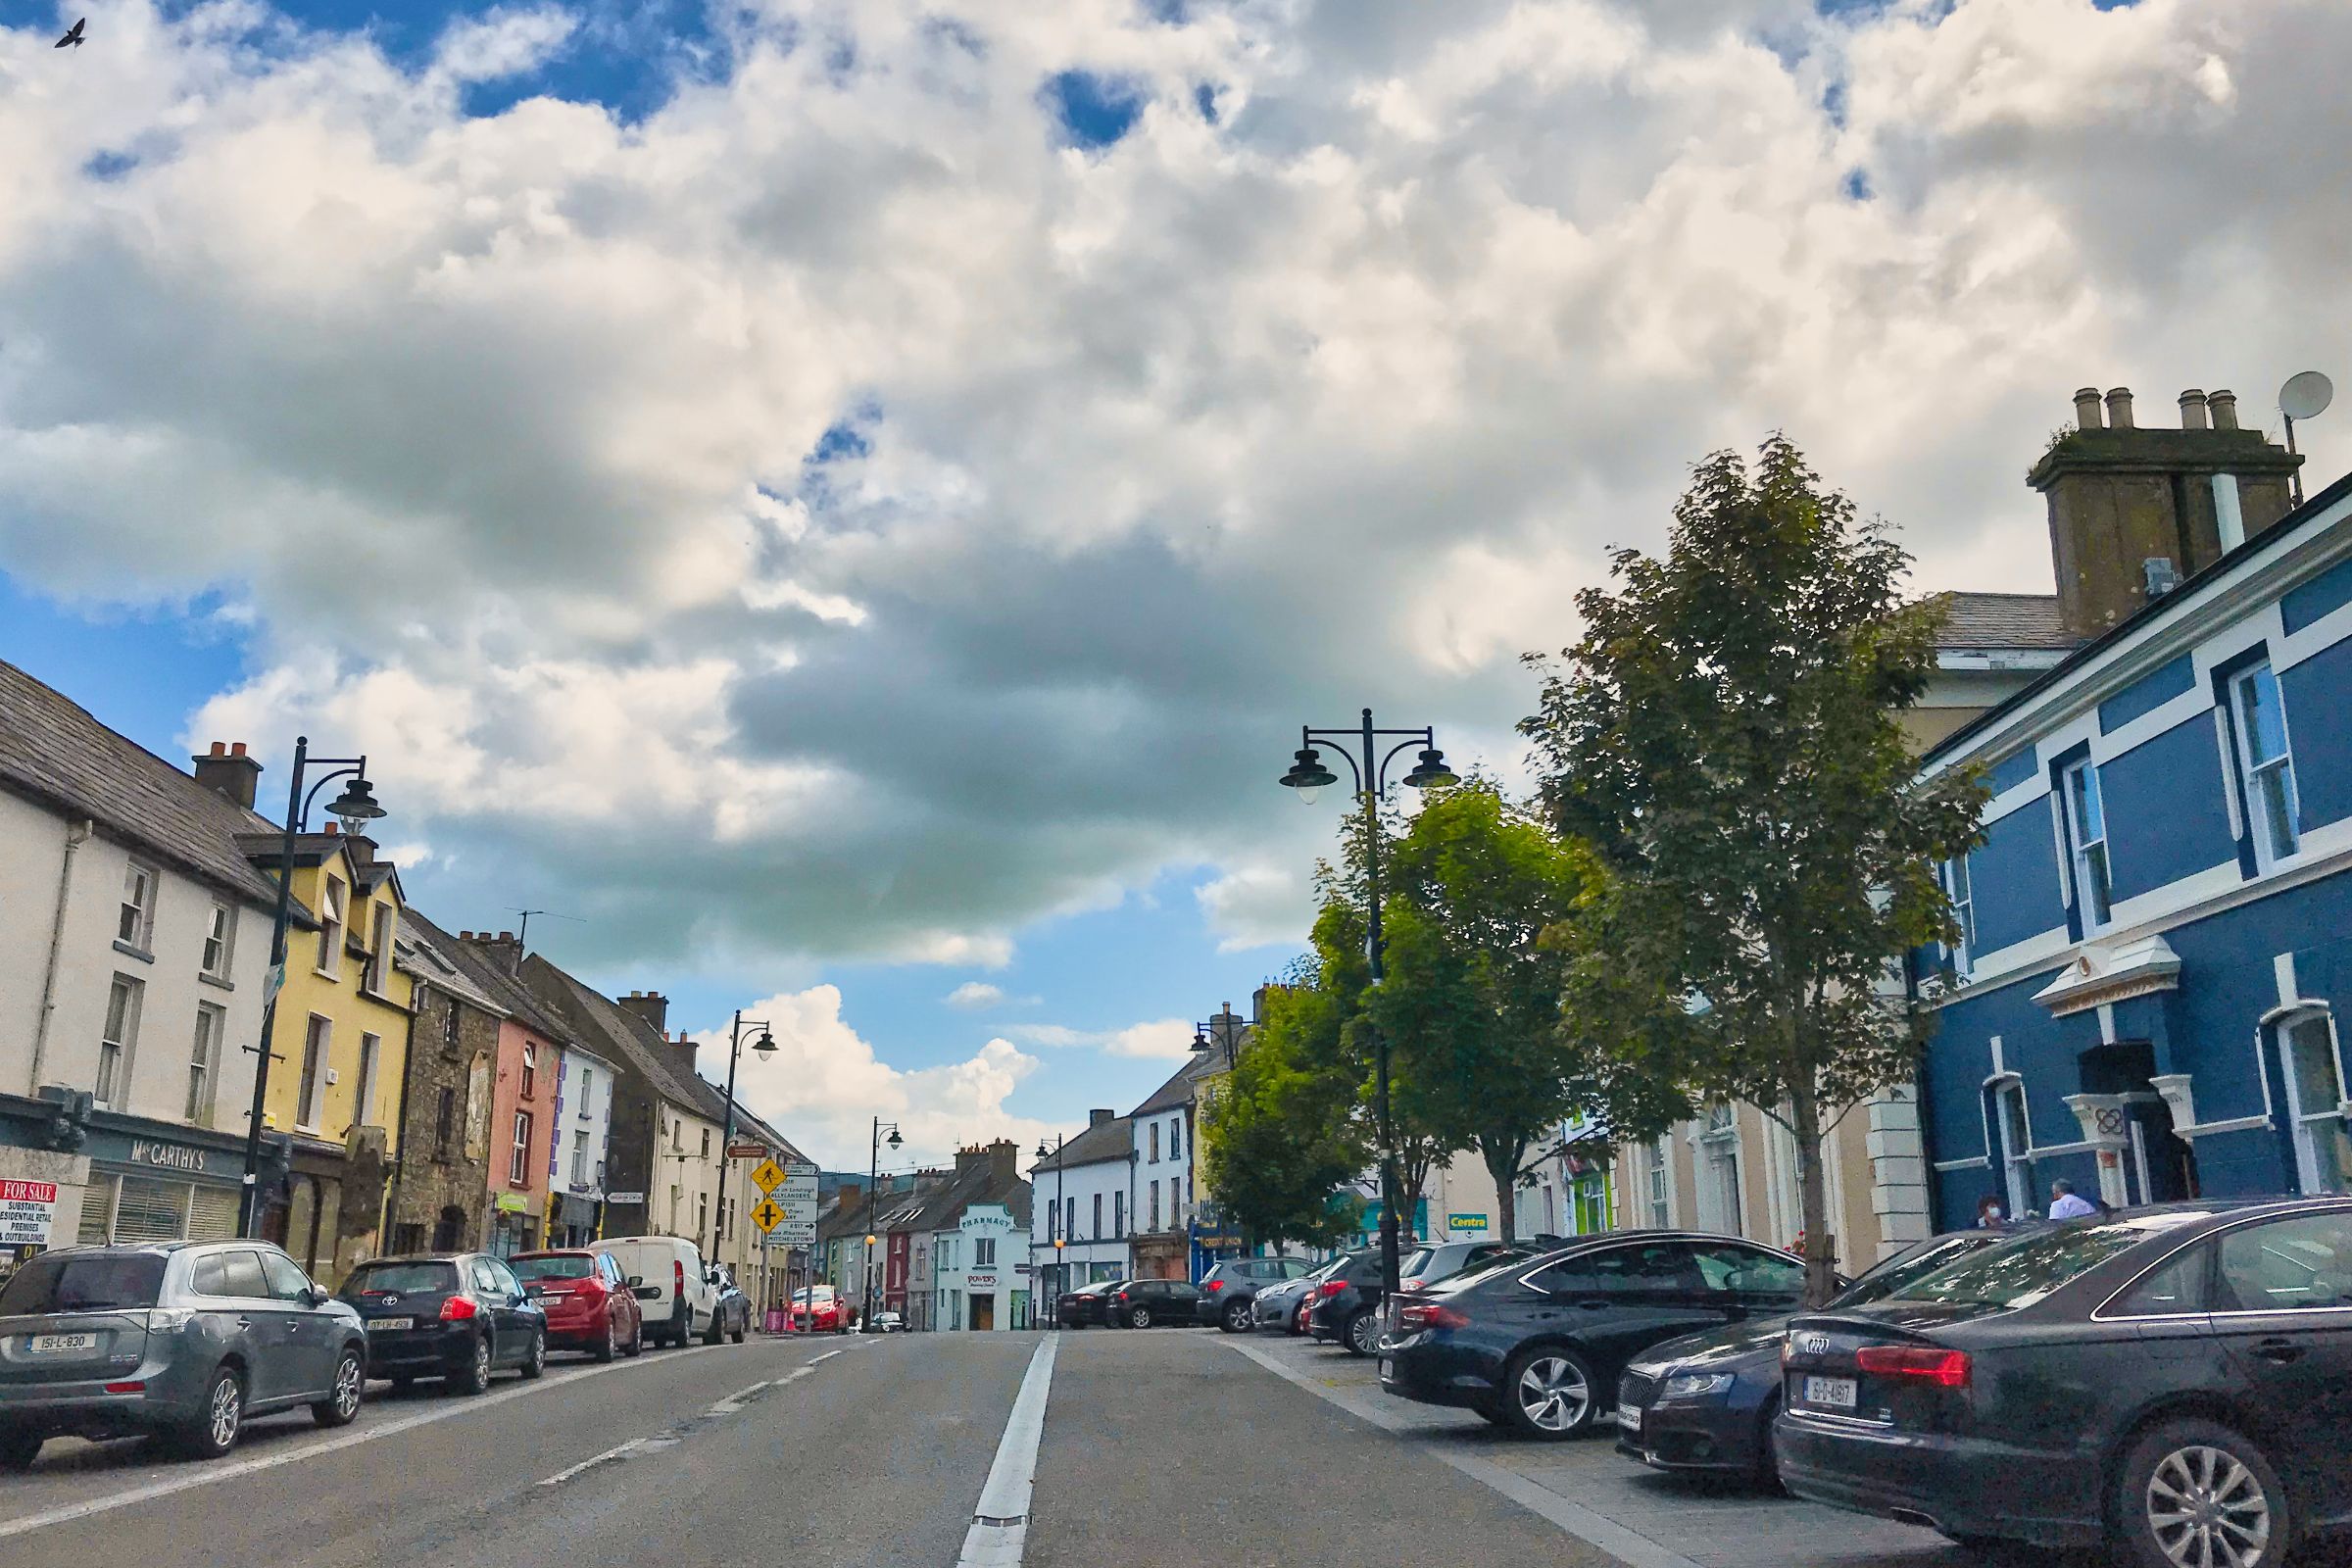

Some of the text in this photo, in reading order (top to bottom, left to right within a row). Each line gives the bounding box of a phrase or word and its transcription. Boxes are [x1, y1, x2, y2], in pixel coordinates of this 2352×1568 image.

[4, 1180, 52, 1201] FOR SALE
[8, 1200, 47, 1212] SUBSTANTIAL
[0, 1210, 52, 1223] ESIDENTIAL RETAIL
[961, 1217, 1010, 1228] PHARMACY
[1450, 1216, 1486, 1227] Centra
[10, 1222, 39, 1233] PREMISES
[41, 1336, 85, 1349] 151-L-830
